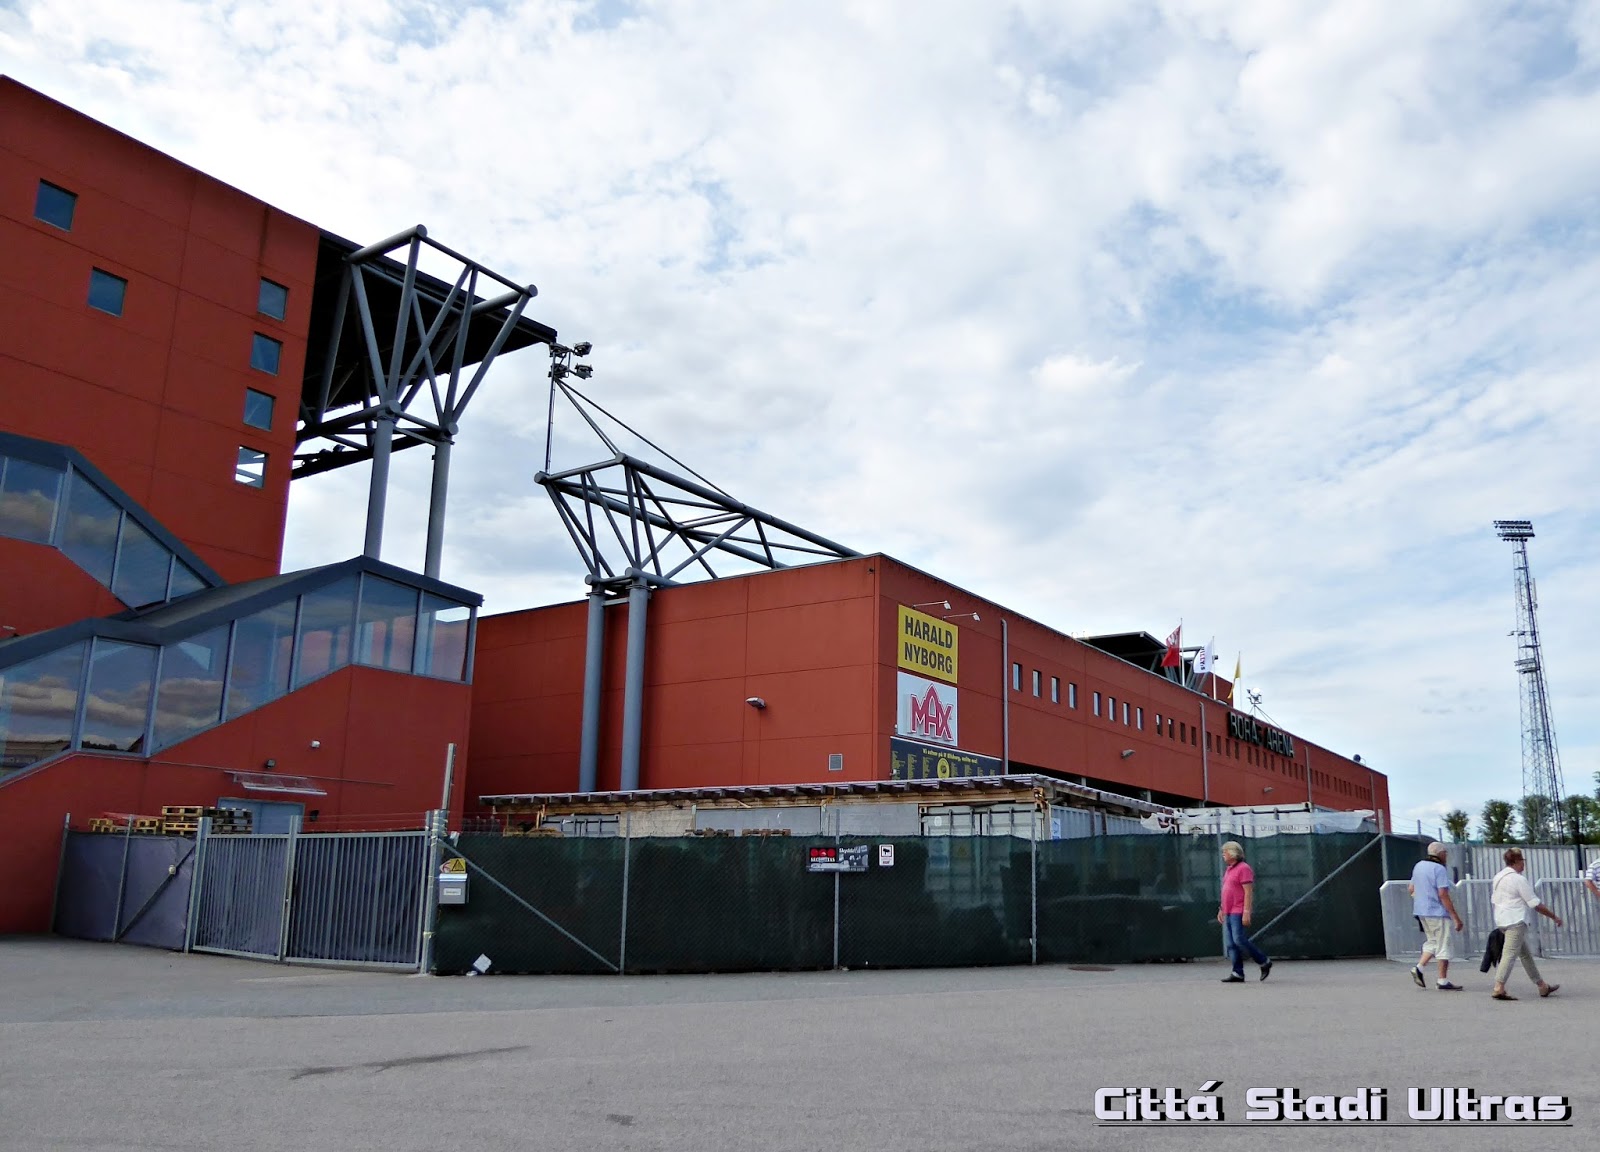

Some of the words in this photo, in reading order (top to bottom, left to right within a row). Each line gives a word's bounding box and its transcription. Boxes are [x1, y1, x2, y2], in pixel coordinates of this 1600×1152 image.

[904, 615, 953, 649] HARALD
[904, 641, 953, 675] NYBORG
[911, 683, 954, 741] MAX
[1265, 726, 1295, 758] ARENA
